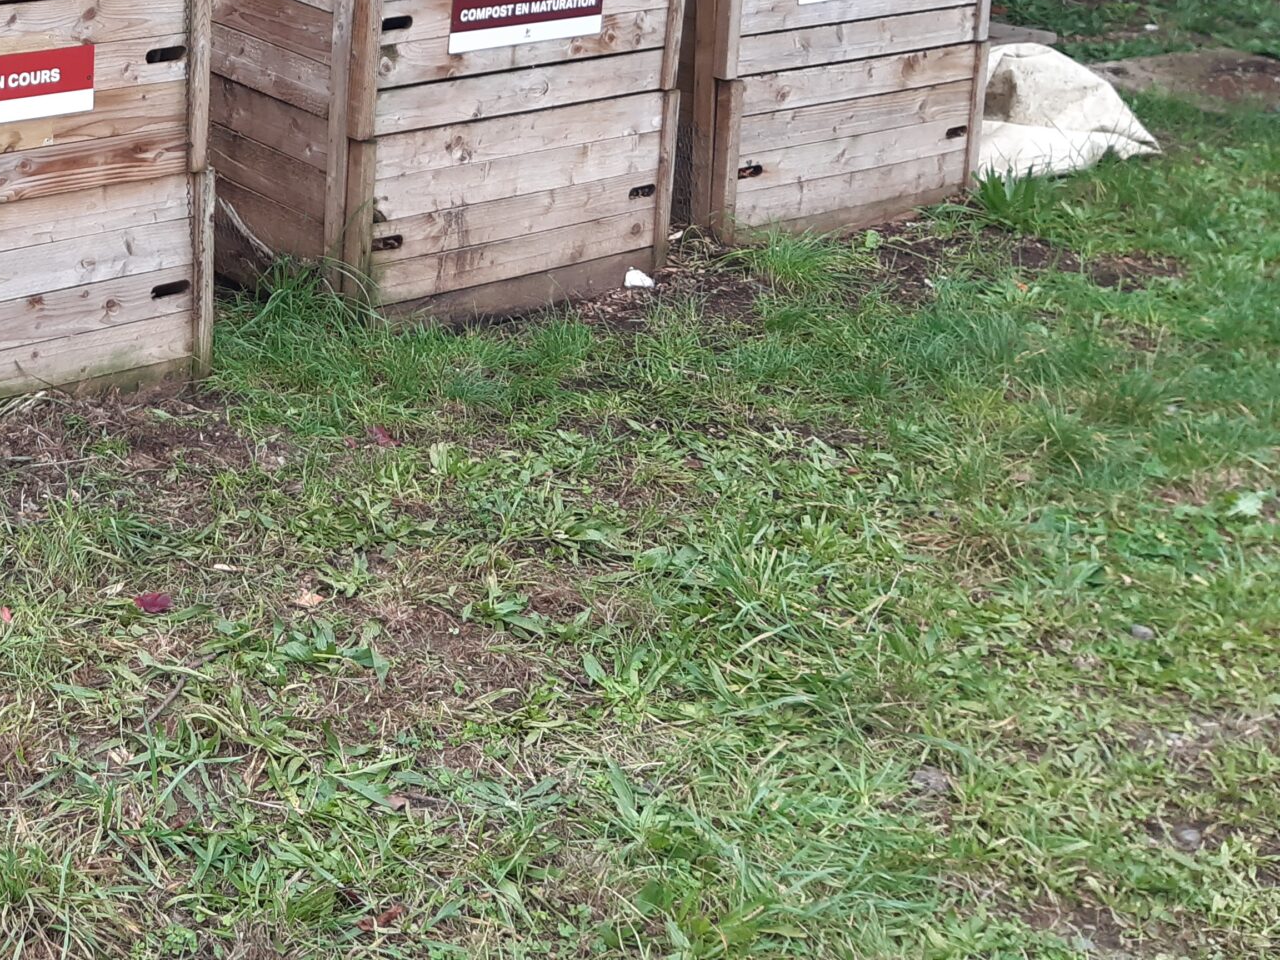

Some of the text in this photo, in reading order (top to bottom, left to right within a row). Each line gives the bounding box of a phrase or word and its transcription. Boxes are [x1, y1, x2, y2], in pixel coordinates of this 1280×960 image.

[460, 4, 514, 22] COMPOST
[515, 2, 529, 15] EN
[7, 68, 61, 88] COURS
